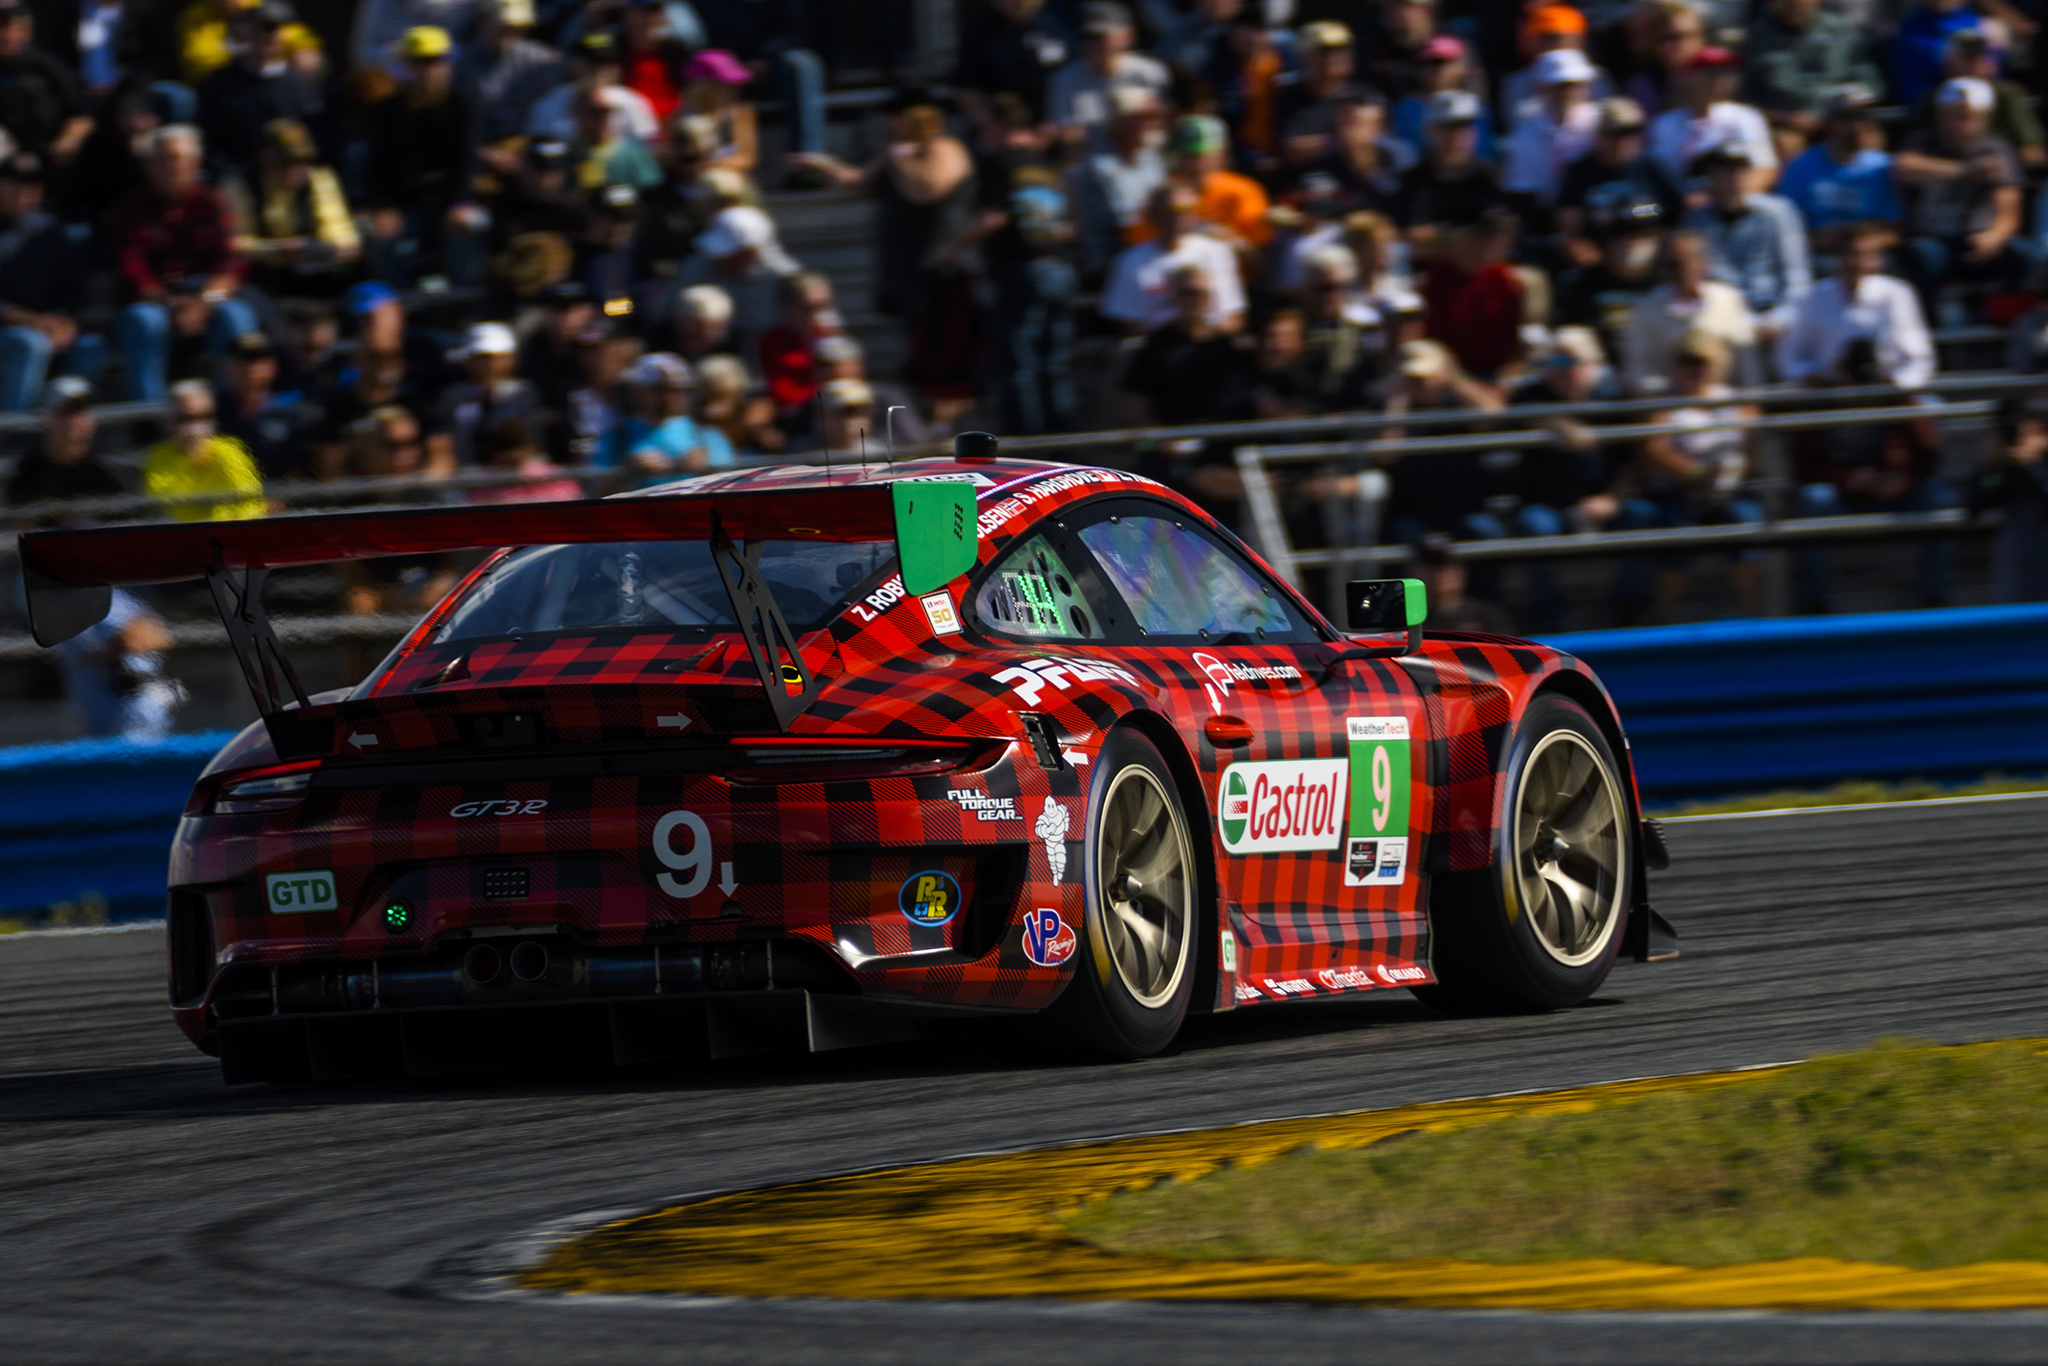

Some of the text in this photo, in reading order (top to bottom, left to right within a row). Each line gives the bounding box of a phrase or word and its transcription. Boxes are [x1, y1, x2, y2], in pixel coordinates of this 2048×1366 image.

[1013, 470, 1101, 505] S. HARGROVE
[850, 573, 906, 621] Z. ROBI
[931, 607, 952, 624] 50
[990, 656, 1140, 707] PFAFF
[1350, 722, 1406, 735] WeatherTech
[947, 788, 986, 801] FULL
[958, 797, 1014, 810] TORQUE
[1250, 771, 1338, 841] Castrol
[1371, 745, 1392, 832] 9
[652, 809, 713, 899] 9
[271, 878, 332, 906] GTD
[1024, 909, 1060, 964] VP
[1047, 938, 1076, 958] Racing
